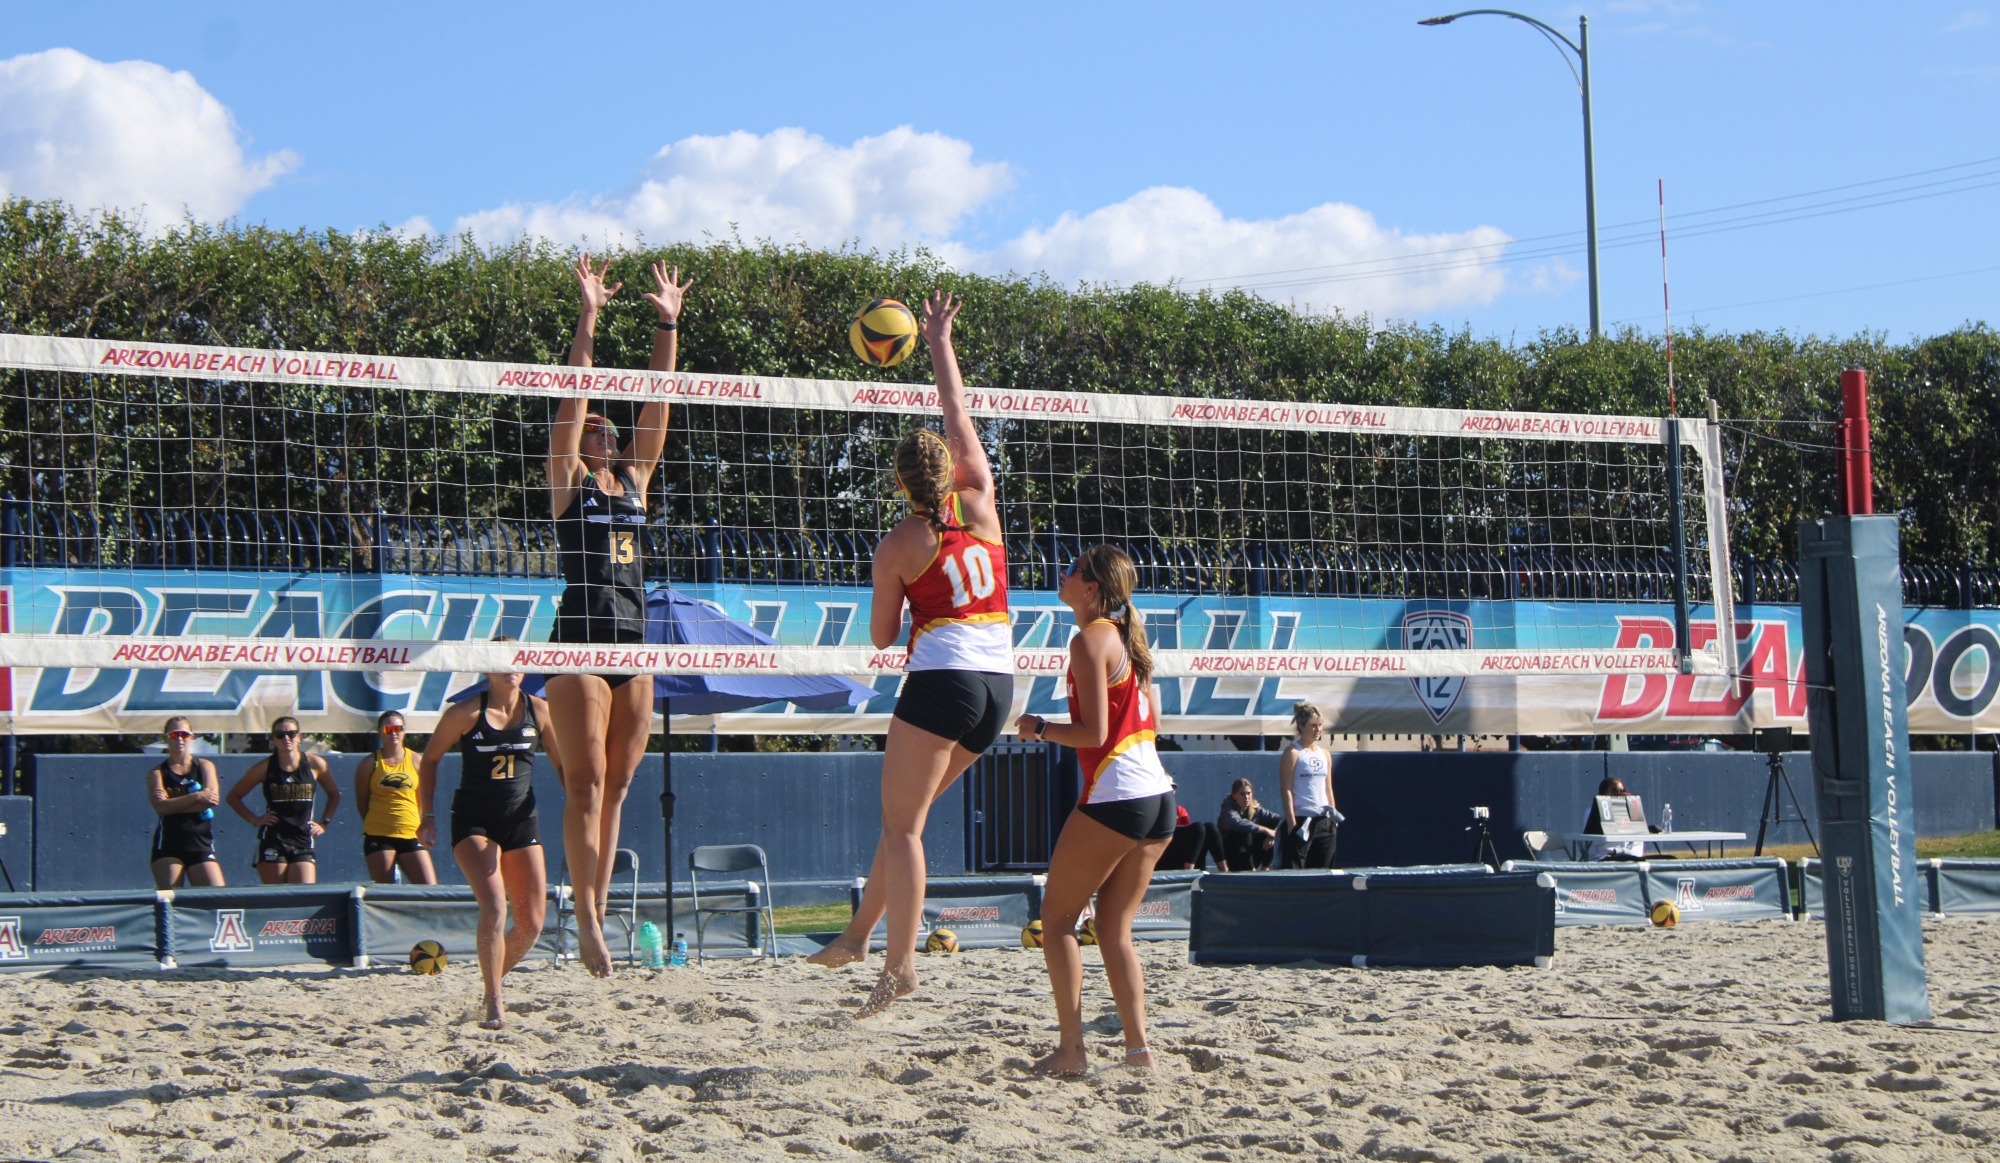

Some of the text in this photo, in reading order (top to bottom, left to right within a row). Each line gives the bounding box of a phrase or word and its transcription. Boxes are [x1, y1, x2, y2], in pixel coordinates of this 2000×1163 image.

[272, 357, 398, 380] VOLLEYBALL
[650, 377, 762, 399] VOLLEYBALL
[988, 395, 1089, 414] VOLLEYBALL
[1295, 408, 1387, 427] VOLLEYBALL
[1574, 420, 1658, 437] VOLLEYBALL
[608, 531, 634, 564] 13
[941, 543, 996, 608] 10
[285, 646, 411, 664] VOLLEYBALL
[664, 652, 779, 669] VOLLEYBALL
[1313, 656, 1407, 671] VOLLEYBALL
[1594, 655, 1679, 669] VOLLEYBALL
[1596, 614, 1808, 722] BEA
[491, 754, 515, 779] 21
[1887, 775, 1904, 908] VOLLEYBALL
[1703, 884, 1755, 900] ARIZONA
[936, 906, 999, 922] ARIZONA
[34, 926, 117, 945] ARIZONA
[258, 918, 337, 936] ARIZONA
[65, 945, 117, 953] VOLLEYBALL
